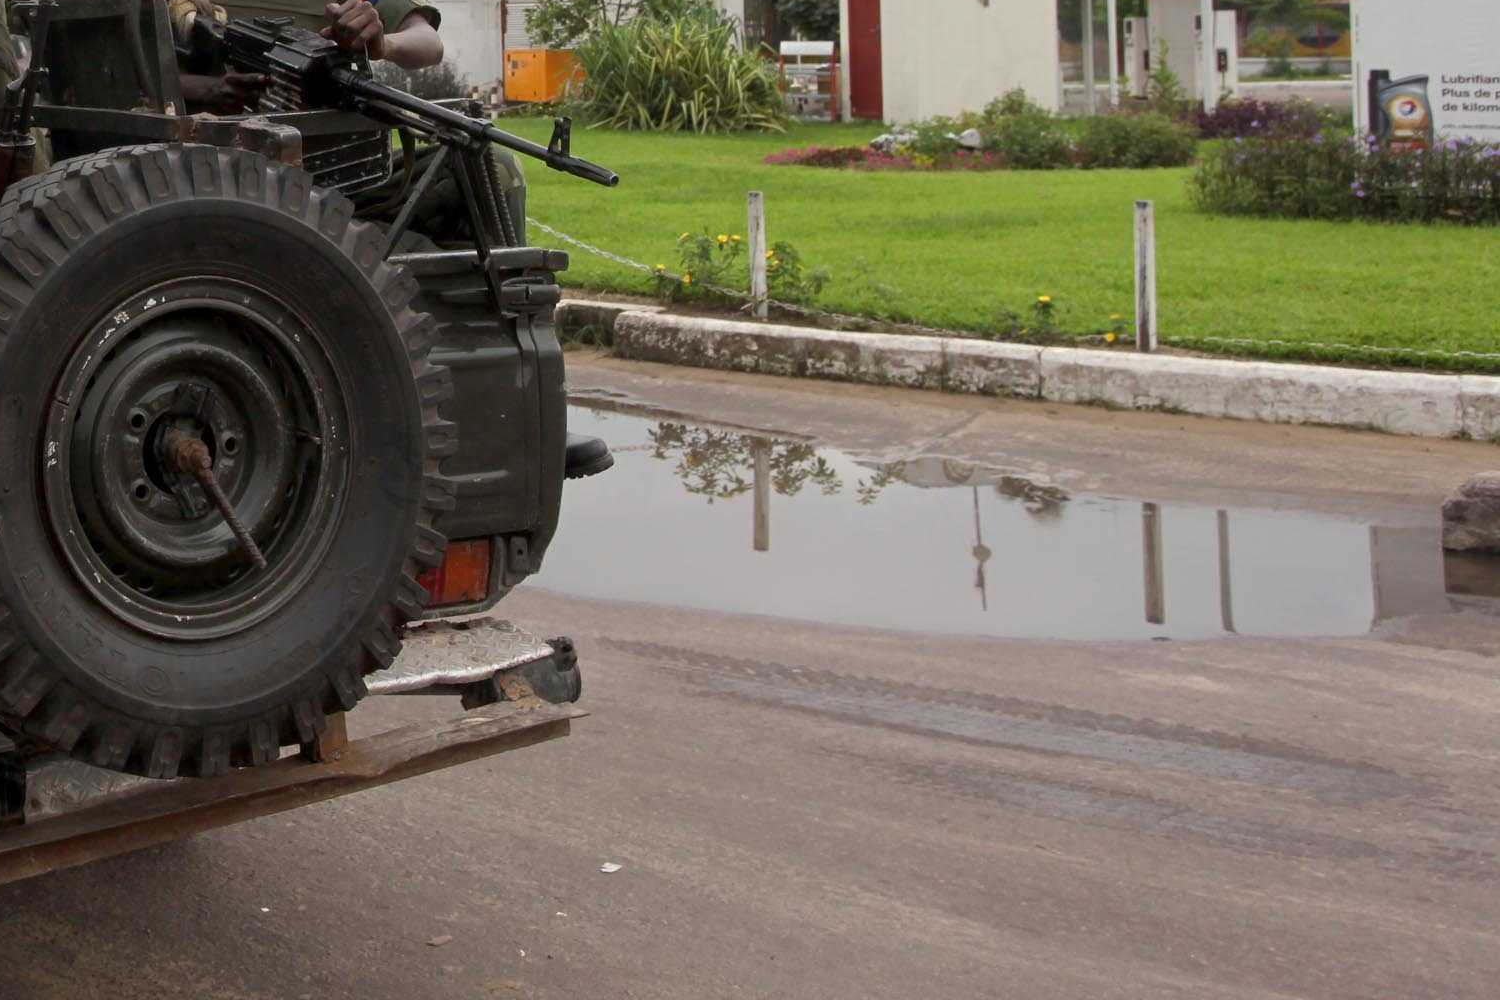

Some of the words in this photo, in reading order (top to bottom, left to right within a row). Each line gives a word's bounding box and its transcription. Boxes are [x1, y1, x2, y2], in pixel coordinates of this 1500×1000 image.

[1441, 75, 1500, 84] Lubrifian
[1442, 88, 1470, 98] Plus
[1474, 89, 1491, 98] de
[1442, 103, 1458, 112] de
